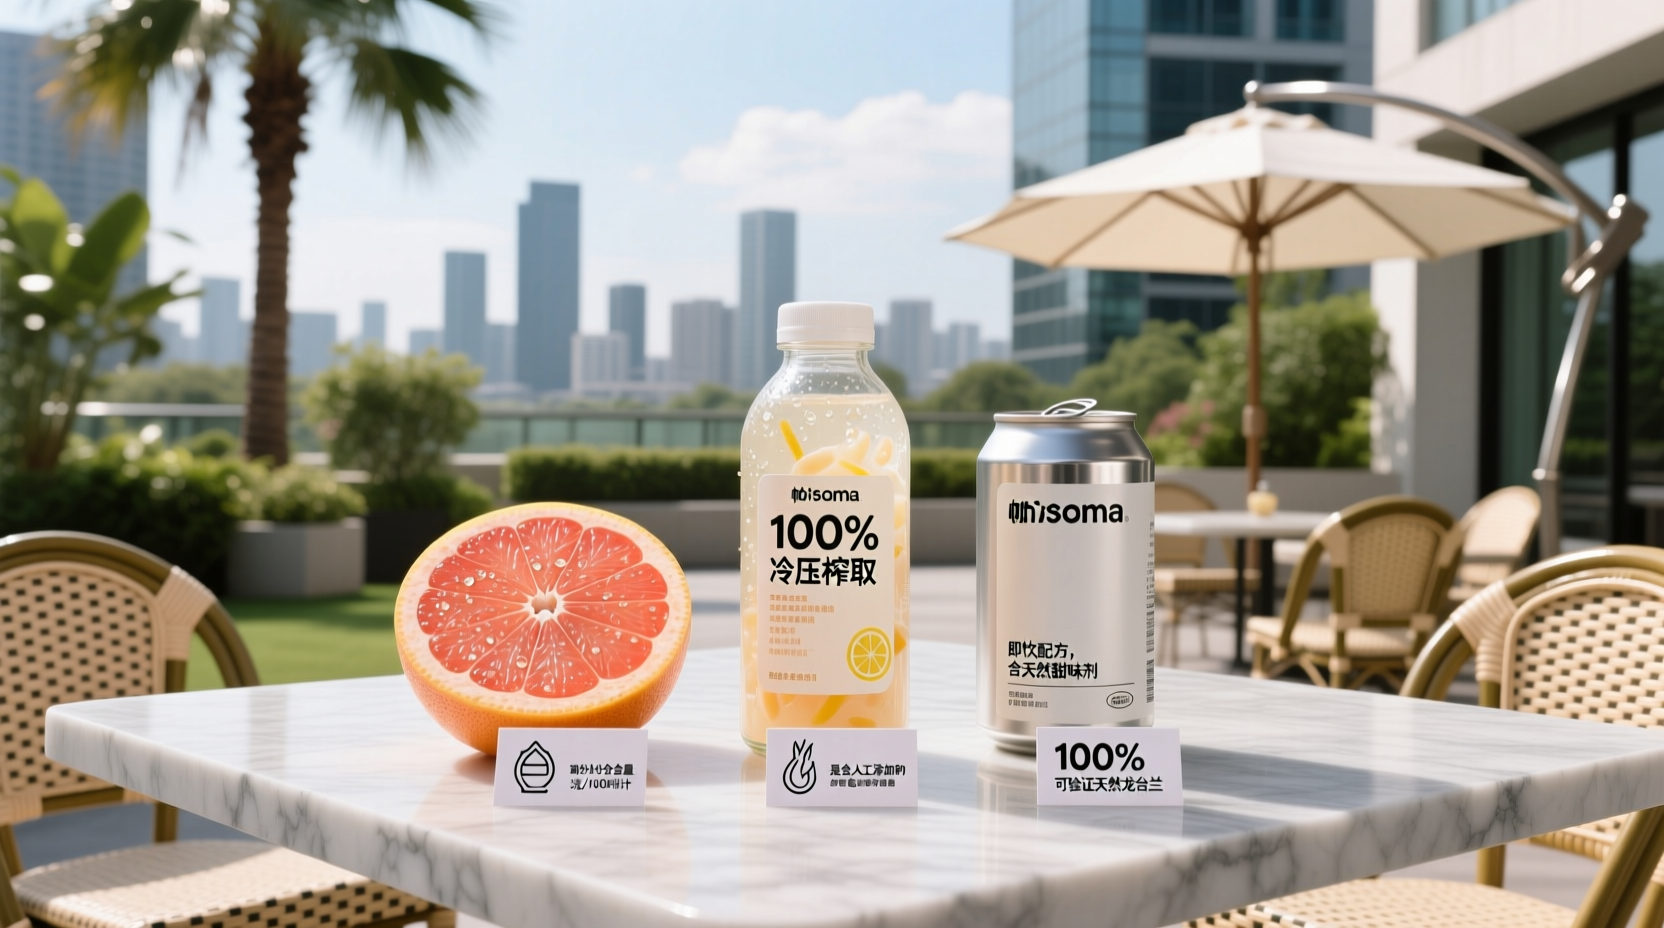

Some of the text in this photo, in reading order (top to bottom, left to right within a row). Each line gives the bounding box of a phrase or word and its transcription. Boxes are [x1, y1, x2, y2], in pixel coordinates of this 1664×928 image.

[770, 513, 879, 551] 100%
[770, 556, 877, 587] 冷压榨取
[1055, 742, 1145, 772] 100%
